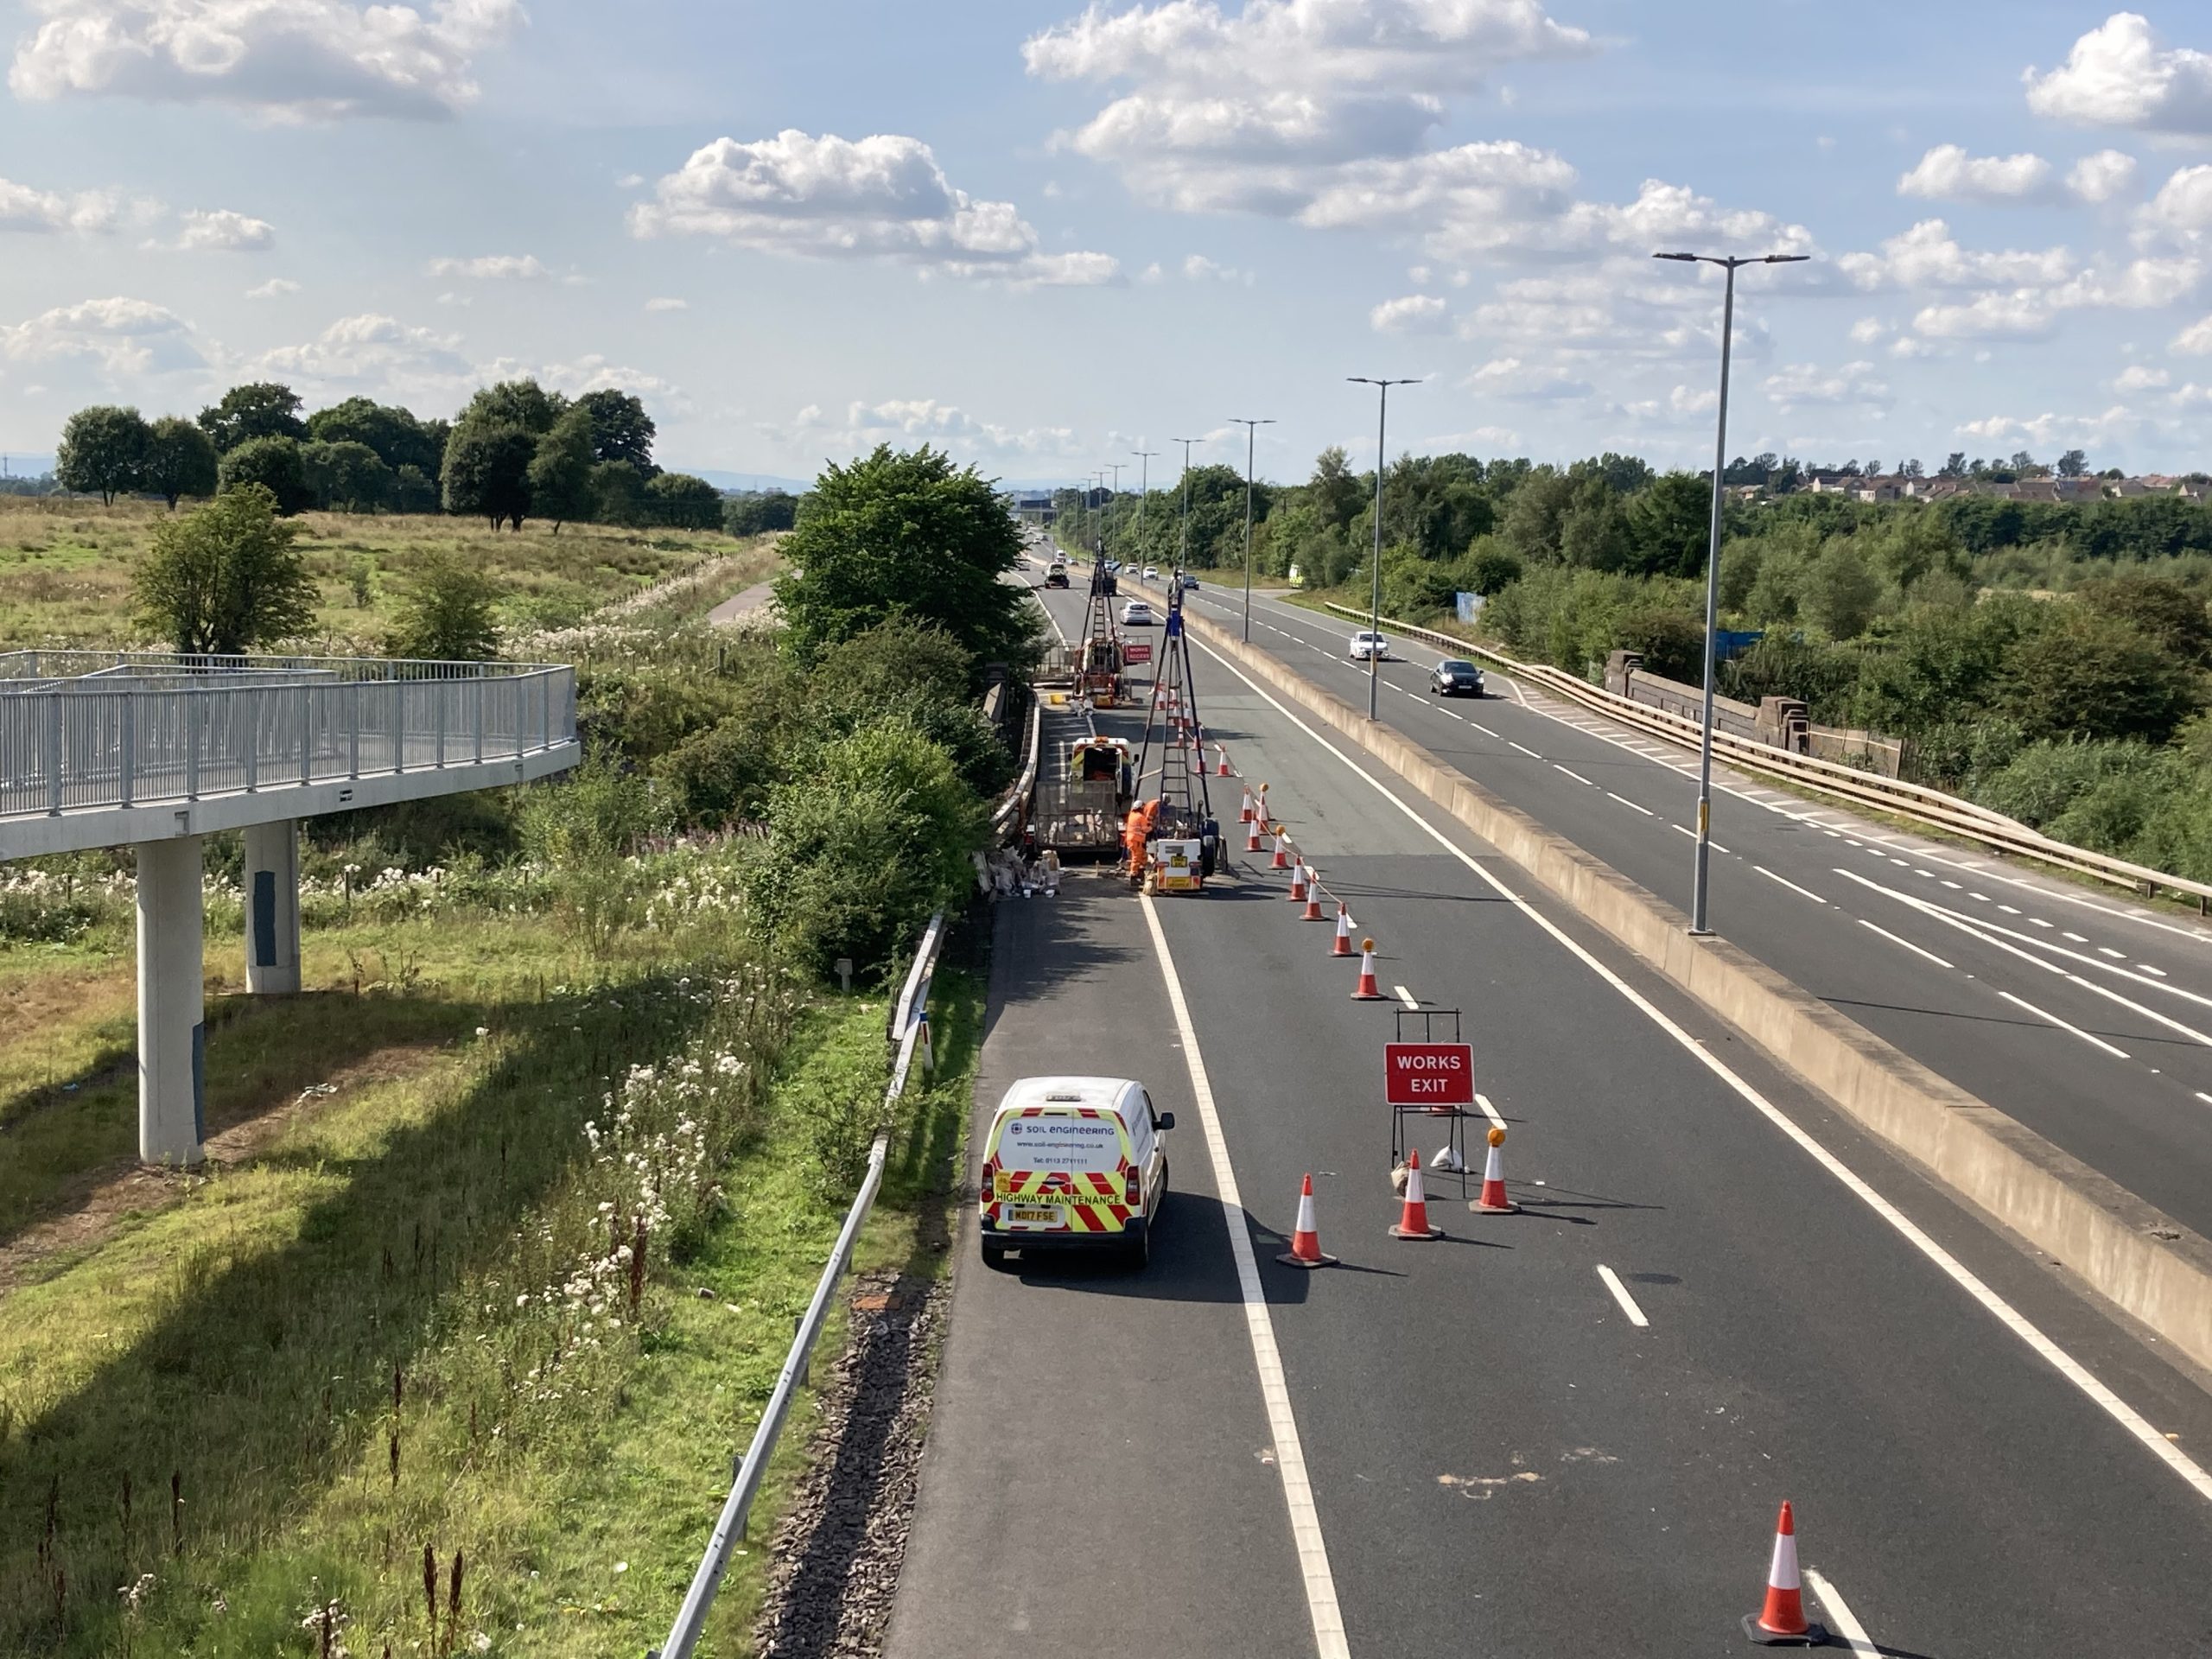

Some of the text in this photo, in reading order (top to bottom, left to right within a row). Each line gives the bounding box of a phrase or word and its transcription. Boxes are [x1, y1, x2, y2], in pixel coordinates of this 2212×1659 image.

[1396, 1055, 1461, 1070] WORKS
[1411, 1078, 1448, 1092] EXIT
[996, 1193, 1121, 1205] HIGHWAY MAINTENANCE
